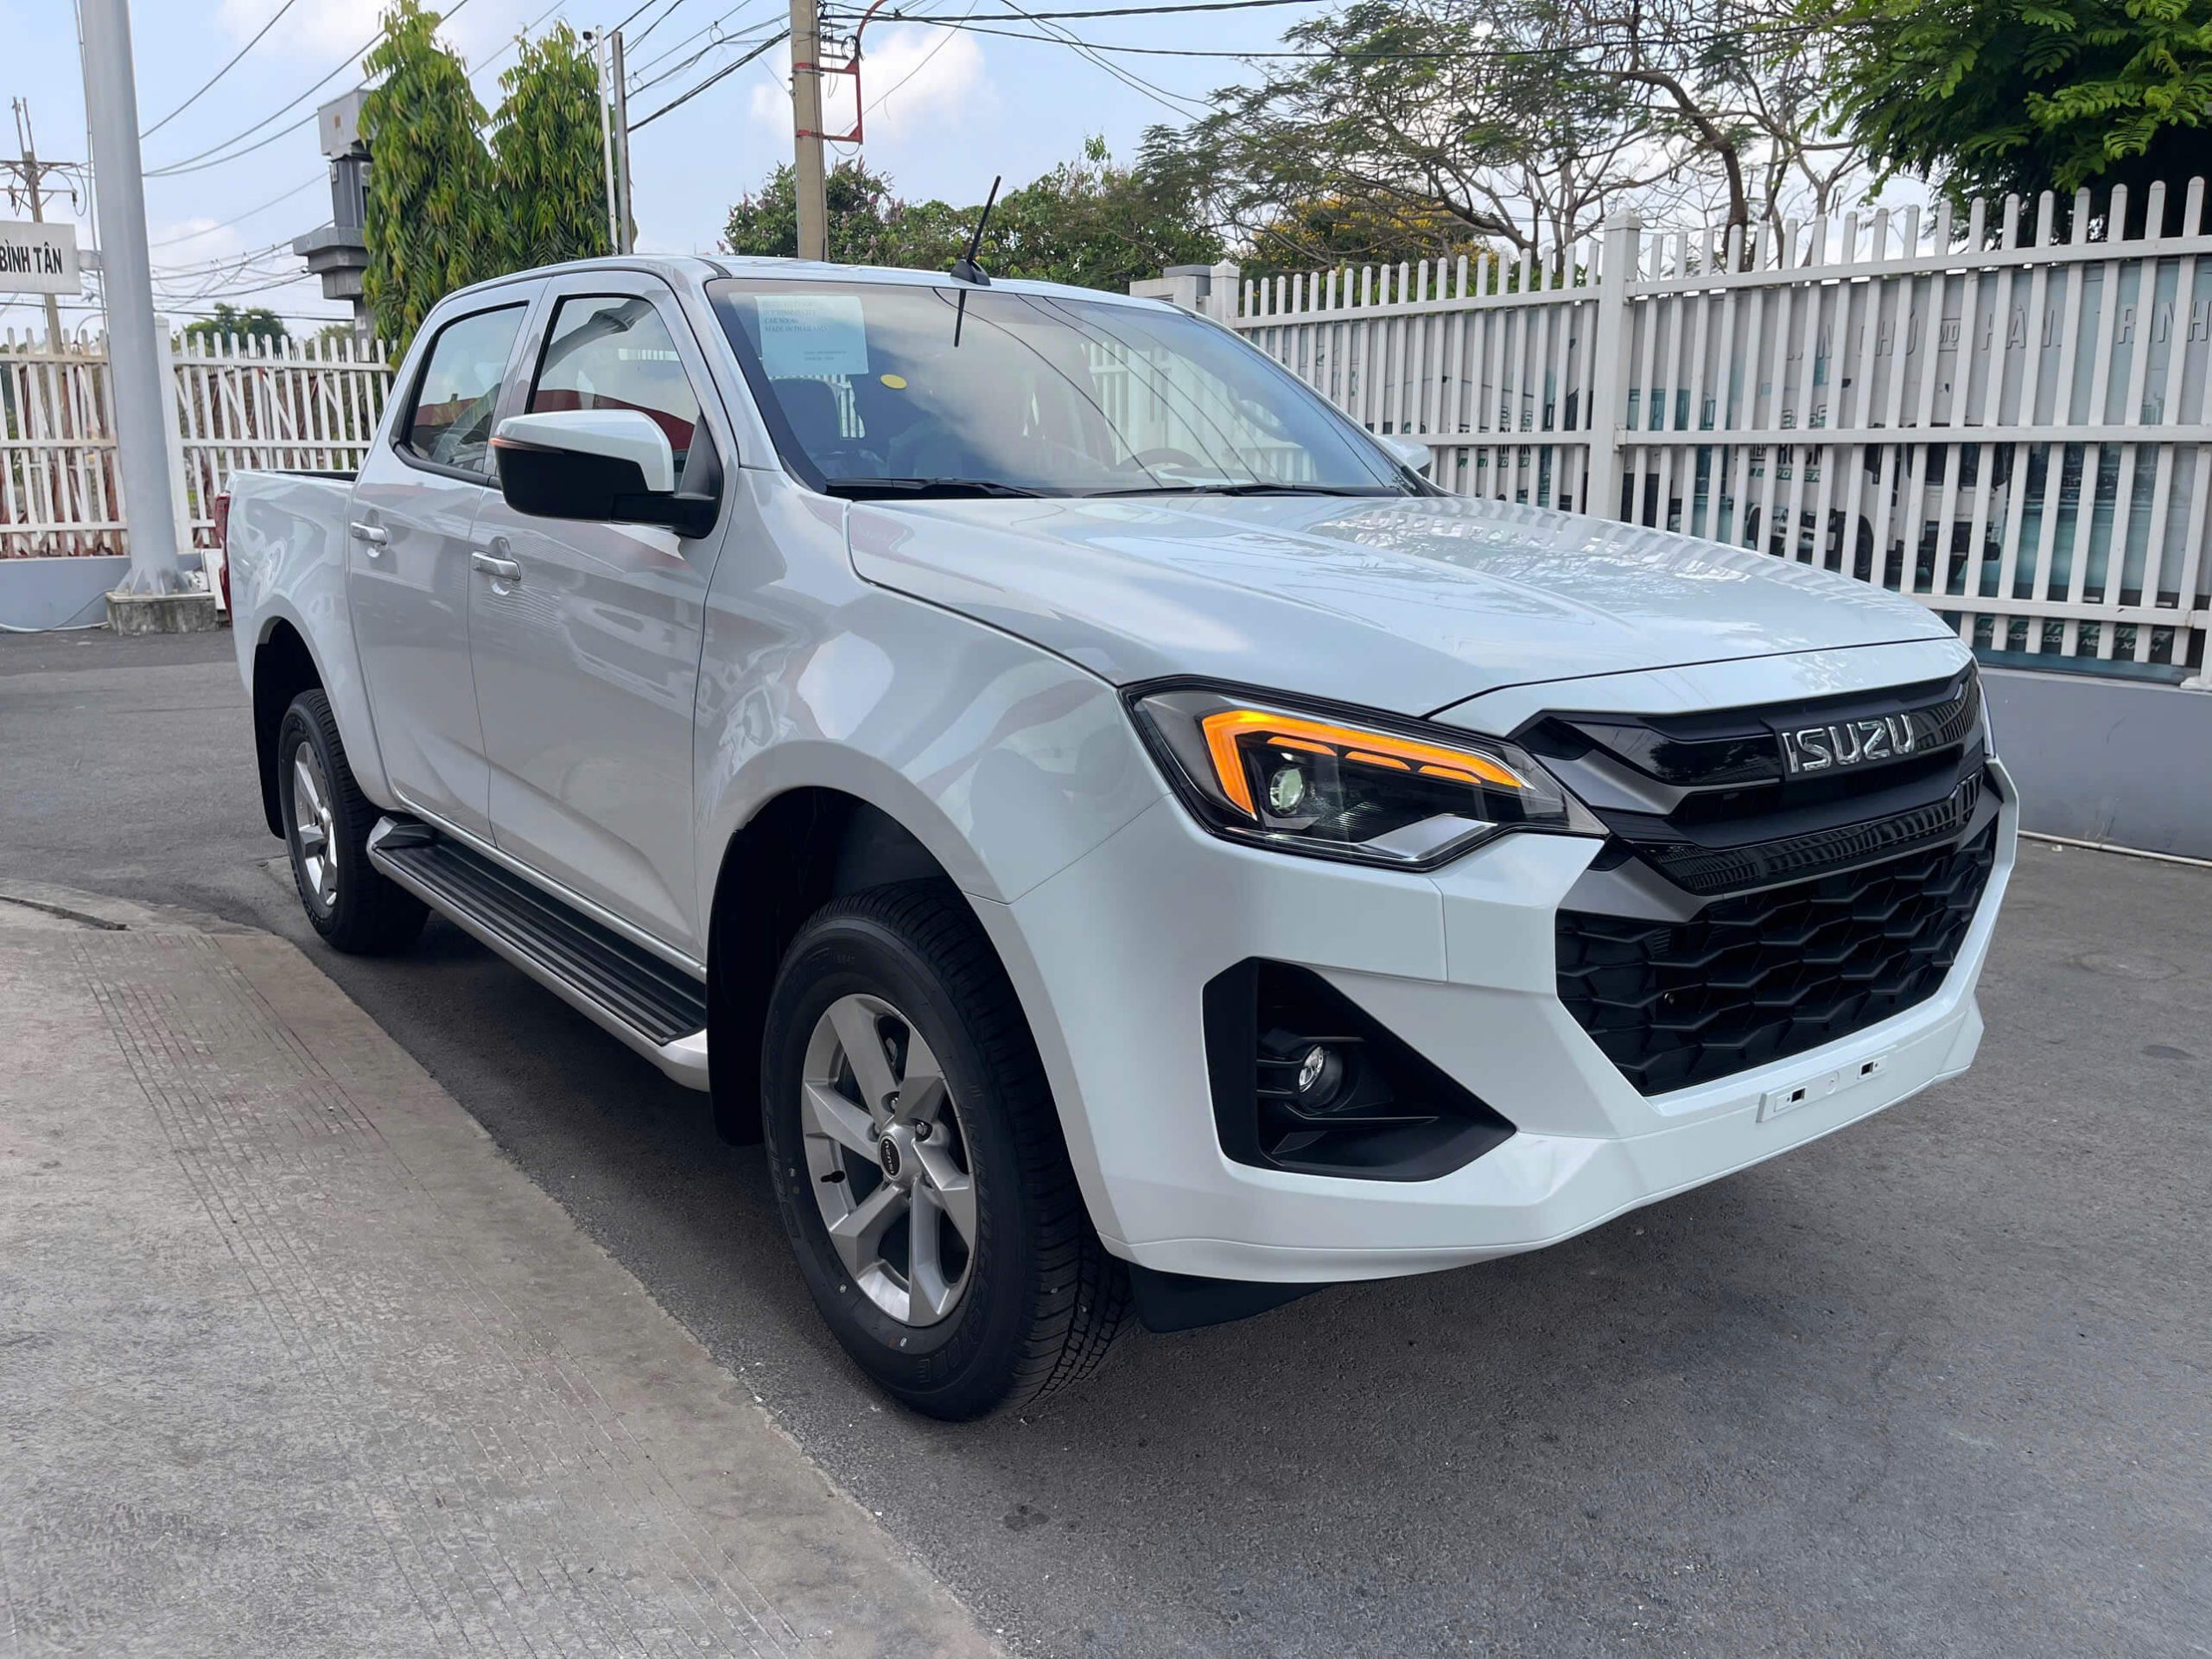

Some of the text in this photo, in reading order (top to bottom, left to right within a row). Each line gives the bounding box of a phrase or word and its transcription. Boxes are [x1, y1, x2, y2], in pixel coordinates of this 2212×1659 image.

[0, 239, 63, 274] BÌNH TÂN
[1782, 714, 1915, 774] ISUZU
